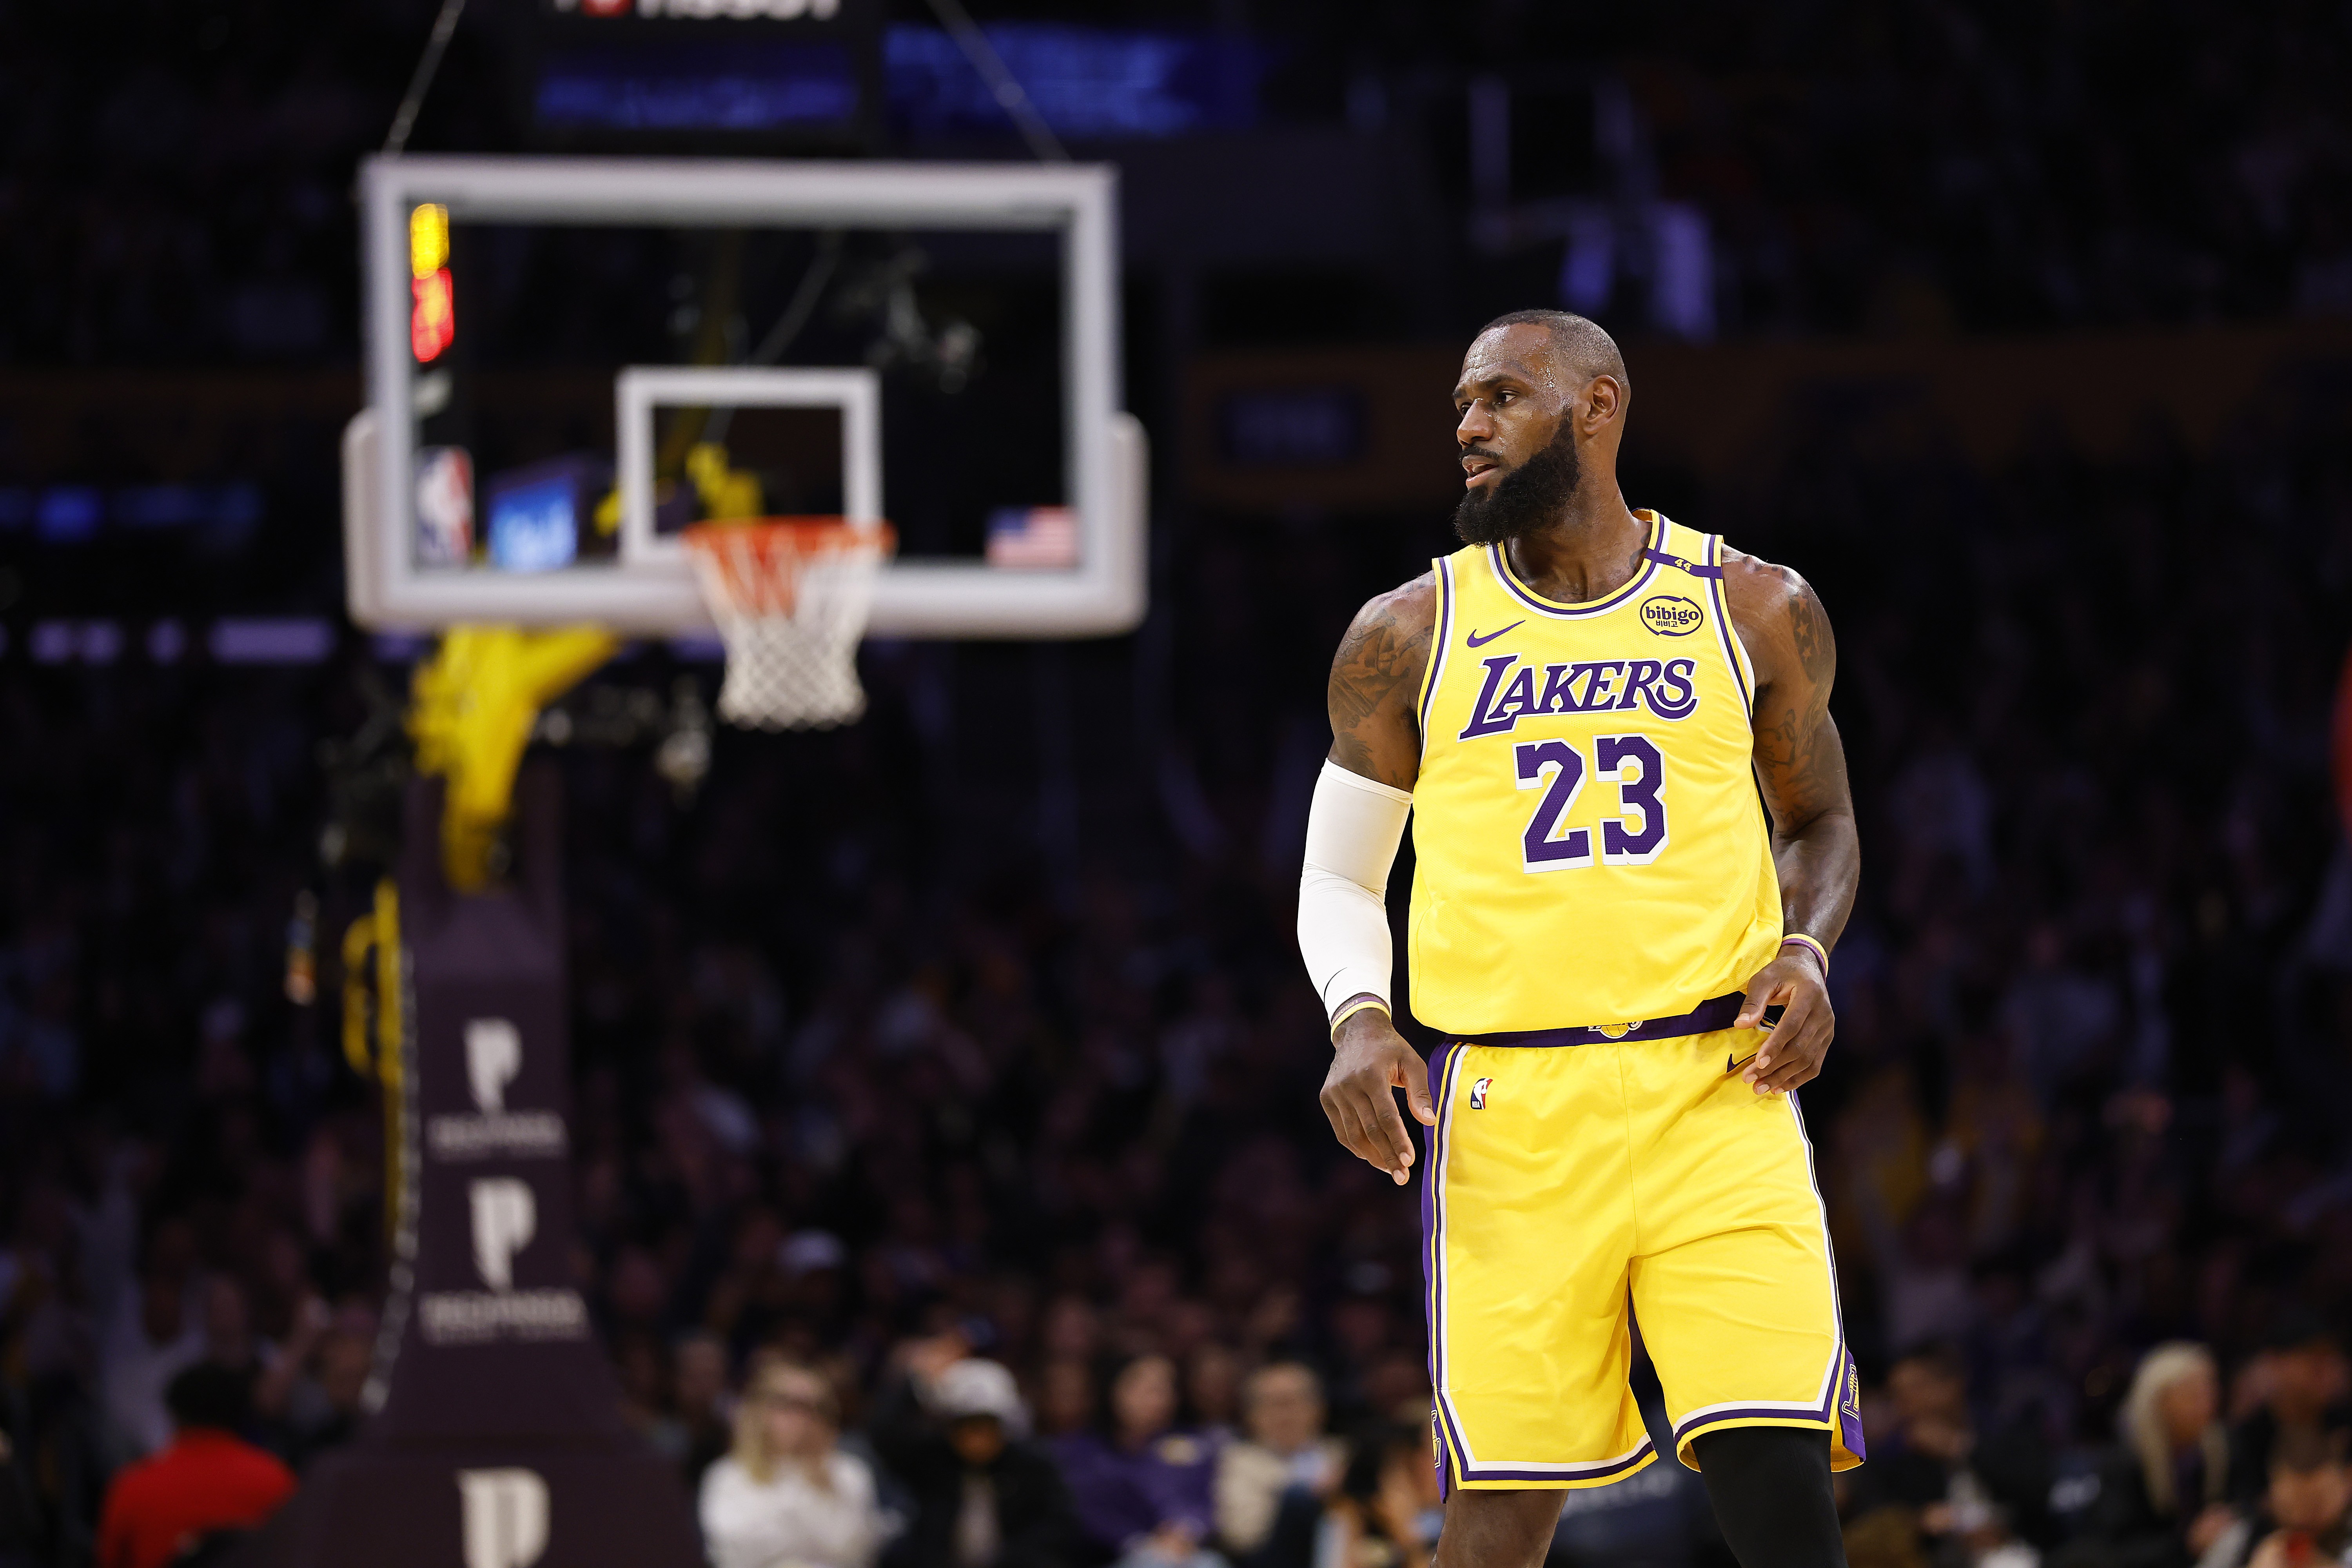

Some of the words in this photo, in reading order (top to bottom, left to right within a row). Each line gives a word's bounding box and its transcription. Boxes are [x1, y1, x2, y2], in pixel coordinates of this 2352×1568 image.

[1674, 559, 1692, 572] 44
[1645, 606, 1699, 625] bibigo
[1457, 652, 1700, 743] LAKERS
[1512, 732, 1670, 874] 23
